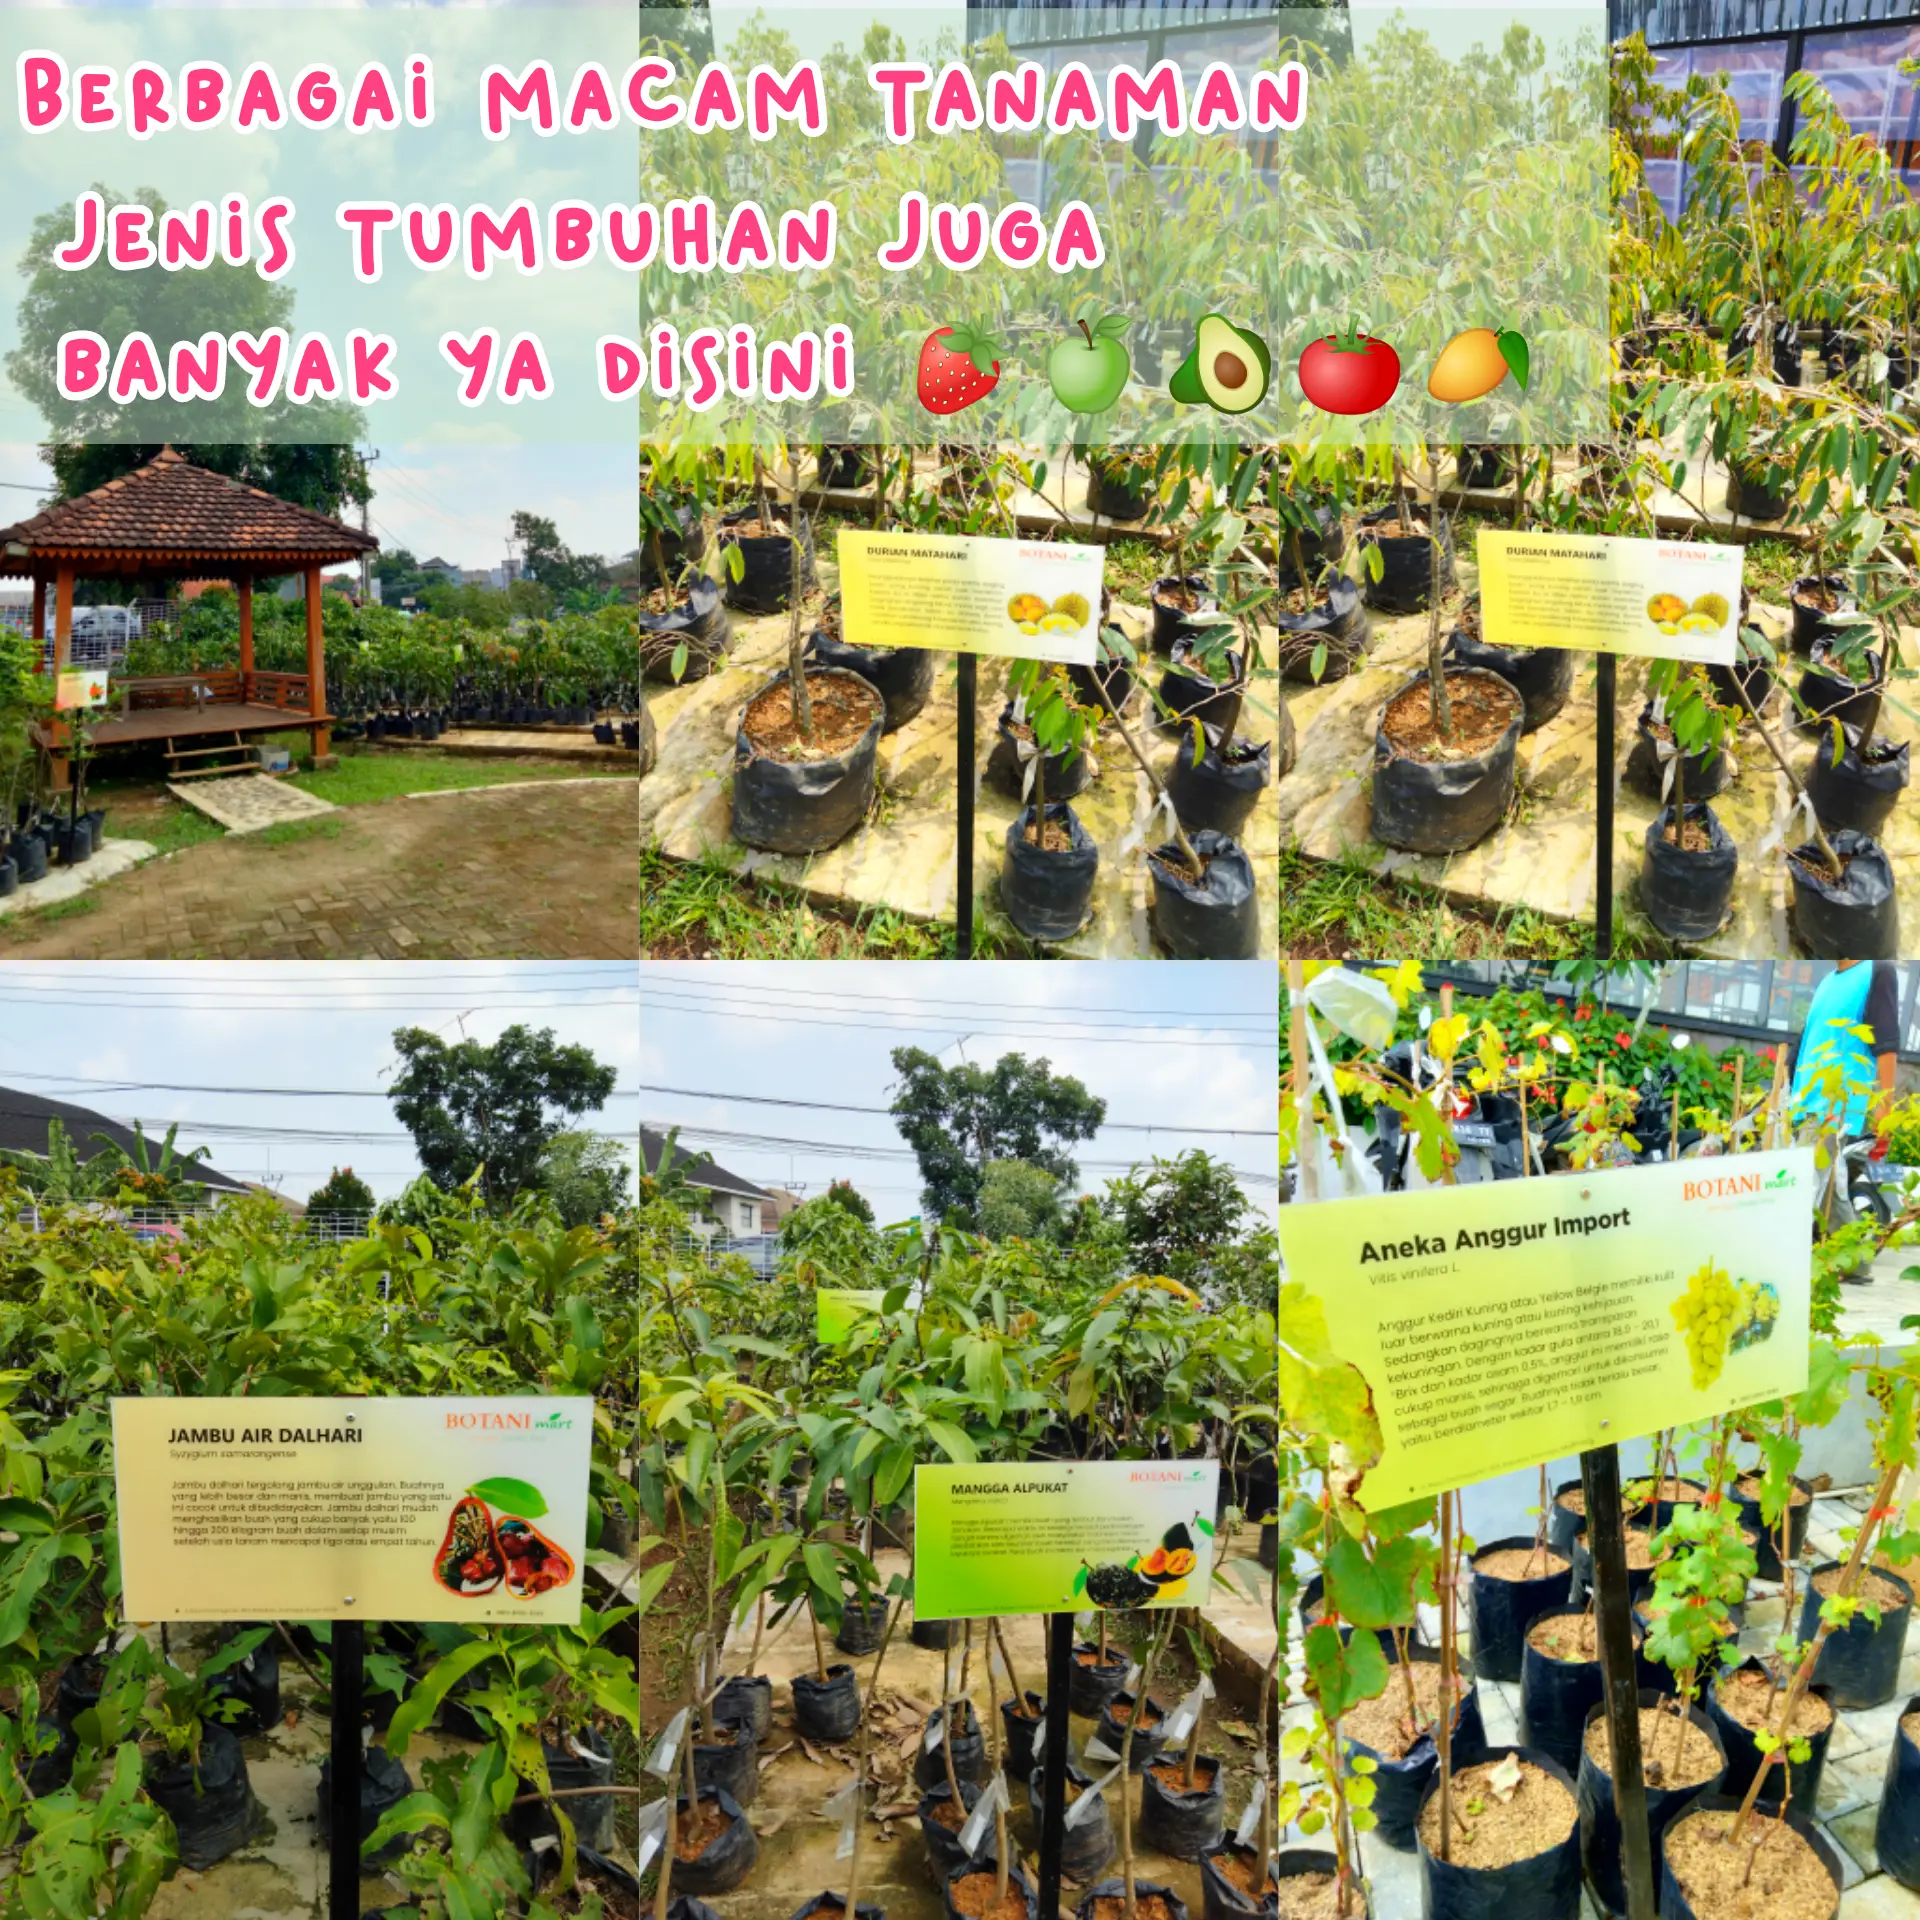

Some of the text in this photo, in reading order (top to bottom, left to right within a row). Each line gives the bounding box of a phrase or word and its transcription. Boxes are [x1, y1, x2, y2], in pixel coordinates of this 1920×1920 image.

[867, 546, 968, 561] DURIAN MATAHARI
[1019, 547, 1067, 561] BOTANI
[1506, 546, 1607, 561] DURIAN MATAHARI
[1658, 547, 1707, 561] BOTANI
[1683, 1173, 1761, 1201] BOTANI
[1359, 1207, 1631, 1264] Aneka Anggur Import
[1378, 1316, 1426, 1333] Anggur
[1428, 1307, 1464, 1323] Kediri
[1465, 1300, 1508, 1316] Kuning
[1510, 1296, 1537, 1309] atau
[1539, 1289, 1573, 1304] Yellow
[1575, 1283, 1609, 1297] Belgie
[1381, 1337, 1407, 1351] luar
[1409, 1324, 1471, 1345] berwarna
[1473, 1316, 1514, 1333] kuning
[1515, 1312, 1541, 1325] atau
[1543, 1304, 1581, 1320] kuning
[1384, 1309, 1637, 1369] Sedangkan dagingnya berwarna transparan
[1465, 1350, 1512, 1367] Dengan
[1514, 1343, 1546, 1357] kadar
[1549, 1337, 1573, 1352] gula
[1575, 1331, 1611, 1346] antara
[1420, 1380, 1446, 1394] dan
[1448, 1371, 1483, 1387] kadar
[1550, 1350, 1589, 1366] anggur
[1394, 1399, 1433, 1417] cukup
[1583, 1359, 1611, 1374] untuk
[1398, 1412, 1448, 1434] sebagai
[1450, 1404, 1482, 1419] buah
[1570, 1377, 1596, 1391] tidak
[445, 1411, 574, 1431] BOTANI mart
[168, 1427, 363, 1444] JAMBU AIR DALHARI
[1401, 1432, 1432, 1450] yaitu
[1434, 1413, 1507, 1440] berdiameter
[1129, 1470, 1183, 1483] BOTANI
[172, 1480, 207, 1491] Jambu
[209, 1480, 244, 1491] dalhari
[246, 1480, 295, 1491] tergolong
[296, 1480, 331, 1491] jambu
[400, 1480, 444, 1491] Buahnya
[951, 1481, 1069, 1495] MANGGA ALPUKAT
[171, 1492, 198, 1503] yang
[199, 1492, 224, 1503] lebih
[256, 1492, 277, 1503] dan
[314, 1492, 364, 1503] membuat
[366, 1492, 400, 1503] jambu
[401, 1492, 427, 1503] yang
[429, 1492, 452, 1503] satu
[186, 1503, 216, 1514] cocok
[218, 1503, 246, 1514] untuk
[327, 1503, 362, 1514] Jambu
[364, 1503, 399, 1514] dalhari
[401, 1503, 439, 1514] mudah
[171, 1514, 243, 1525] menghasilkan
[244, 1514, 271, 1525] buah
[273, 1514, 299, 1525] yang
[301, 1514, 331, 1525] cukup
[332, 1514, 370, 1525] banyak
[371, 1514, 398, 1525] yaitu
[173, 1525, 209, 1536] hingga
[276, 1525, 302, 1536] buah
[304, 1525, 338, 1536] dalam
[235, 1537, 269, 1547] tanam
[370, 1537, 403, 1547] empat
